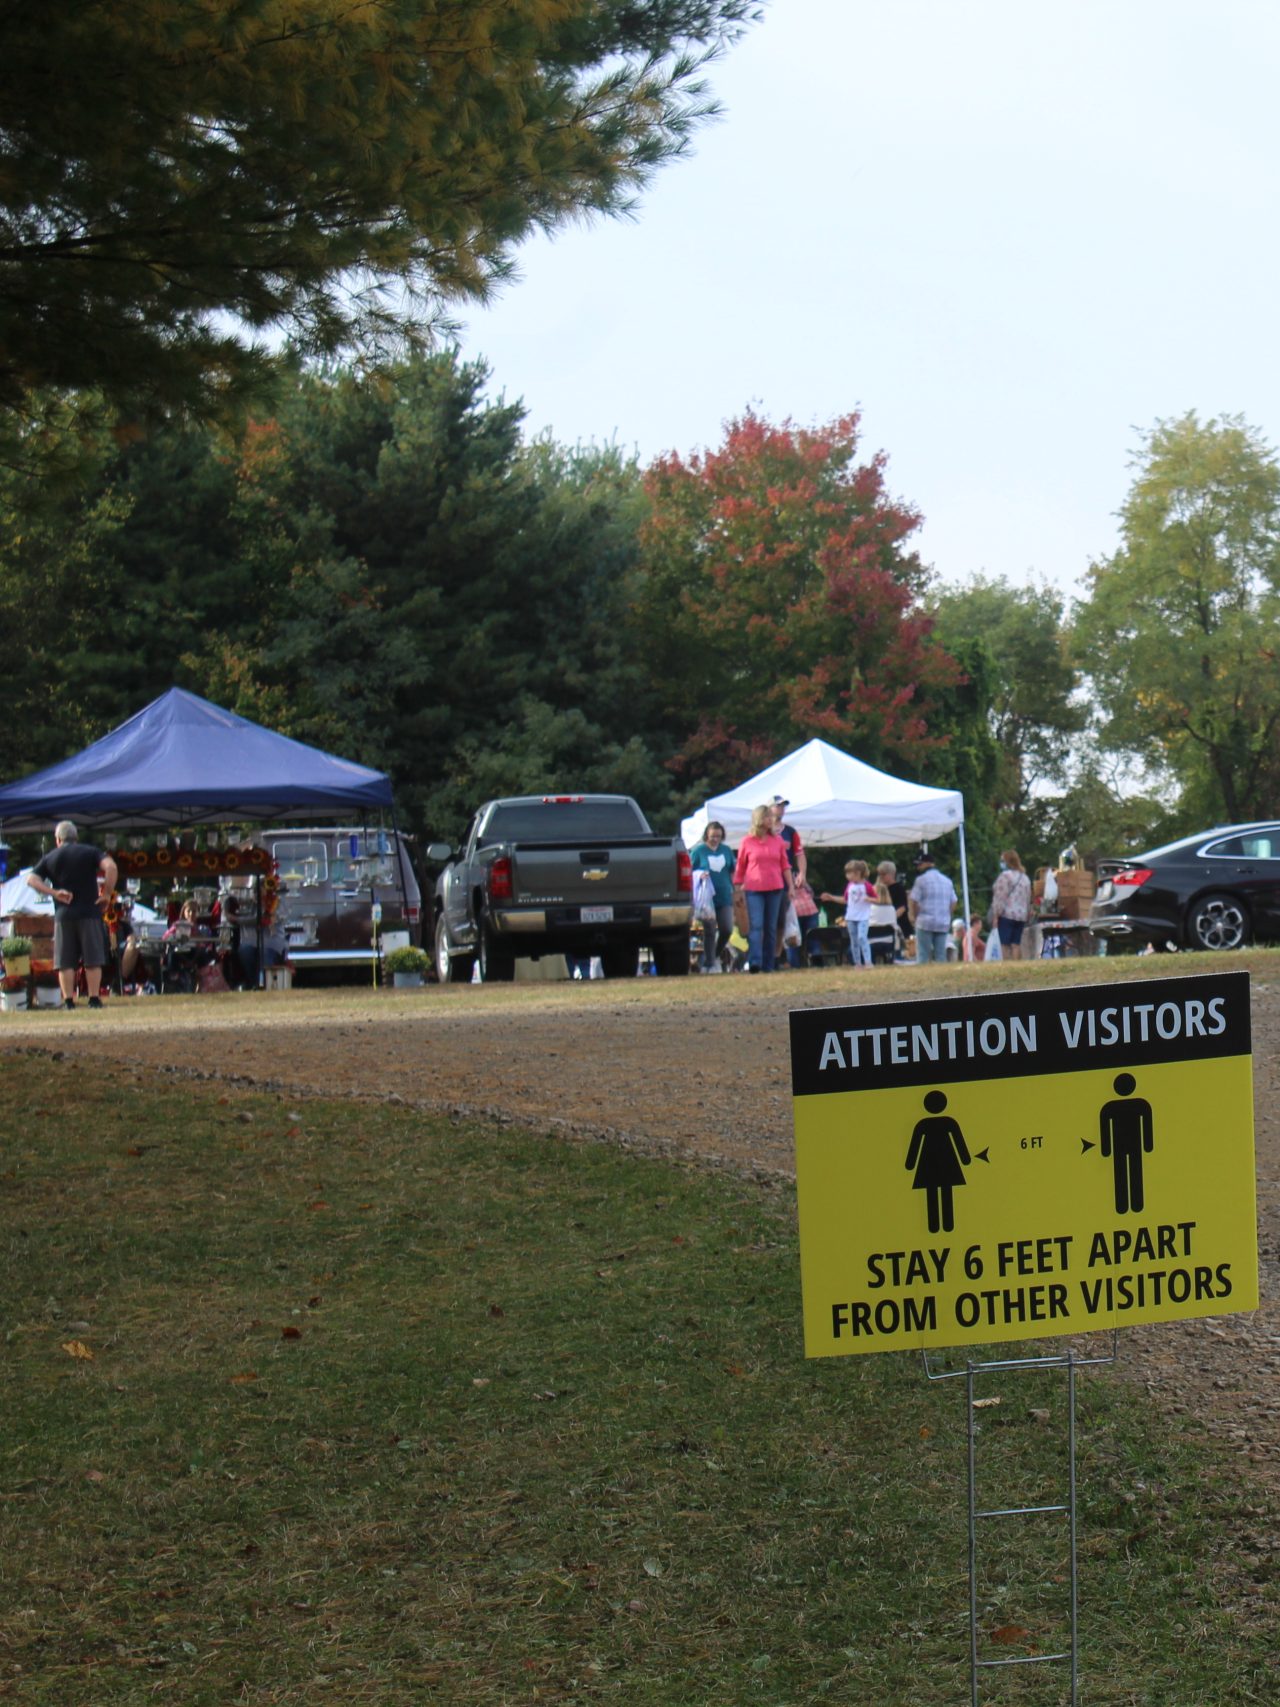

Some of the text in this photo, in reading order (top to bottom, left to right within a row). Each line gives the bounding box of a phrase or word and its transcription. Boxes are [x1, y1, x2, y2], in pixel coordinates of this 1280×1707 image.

[818, 997, 1227, 1070] ATTENTION VISITORS
[1020, 1136, 1044, 1150] 6 FT
[867, 1221, 1196, 1289] STAY 6 FEET APART
[831, 1263, 1232, 1339] FROM OTHER VISITORS
